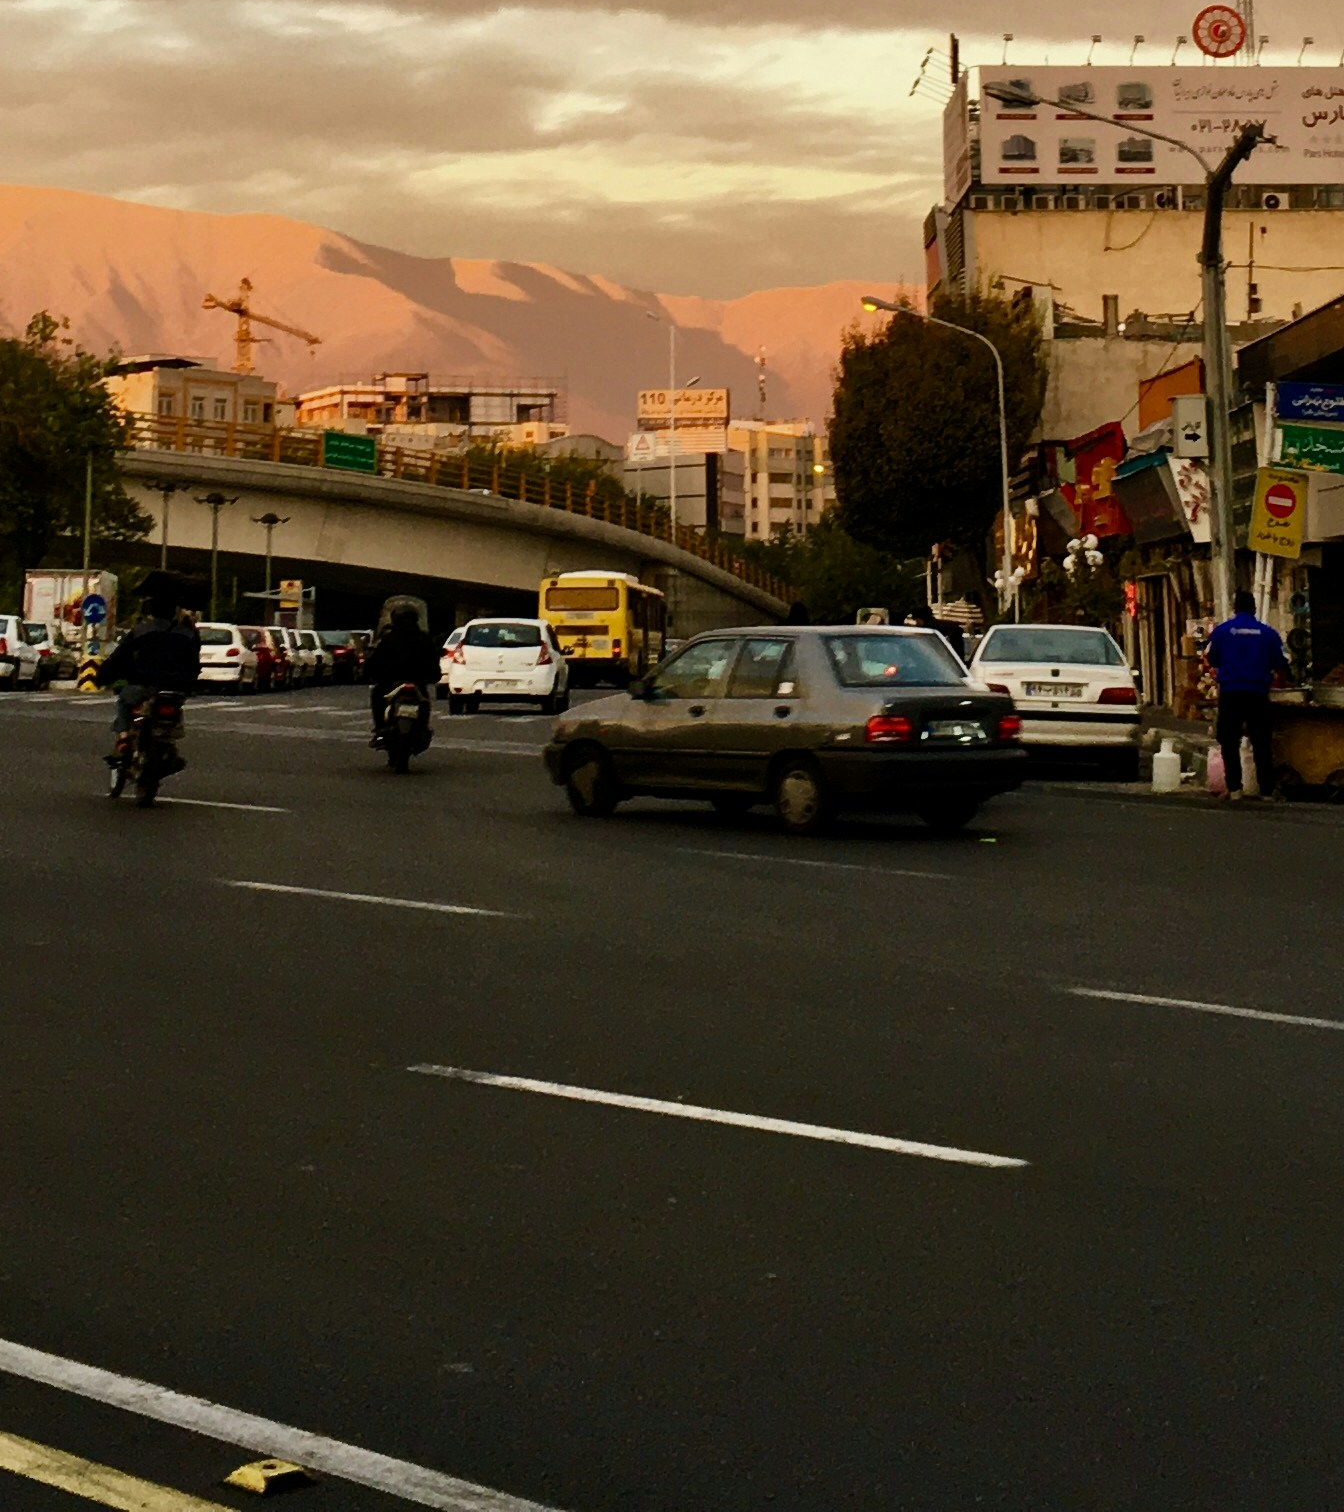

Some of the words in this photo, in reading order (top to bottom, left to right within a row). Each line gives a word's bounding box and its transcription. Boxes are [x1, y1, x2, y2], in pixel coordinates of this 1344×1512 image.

[1301, 86, 1323, 99] های
[1324, 87, 1344, 100] هتل
[640, 392, 667, 405] 110
